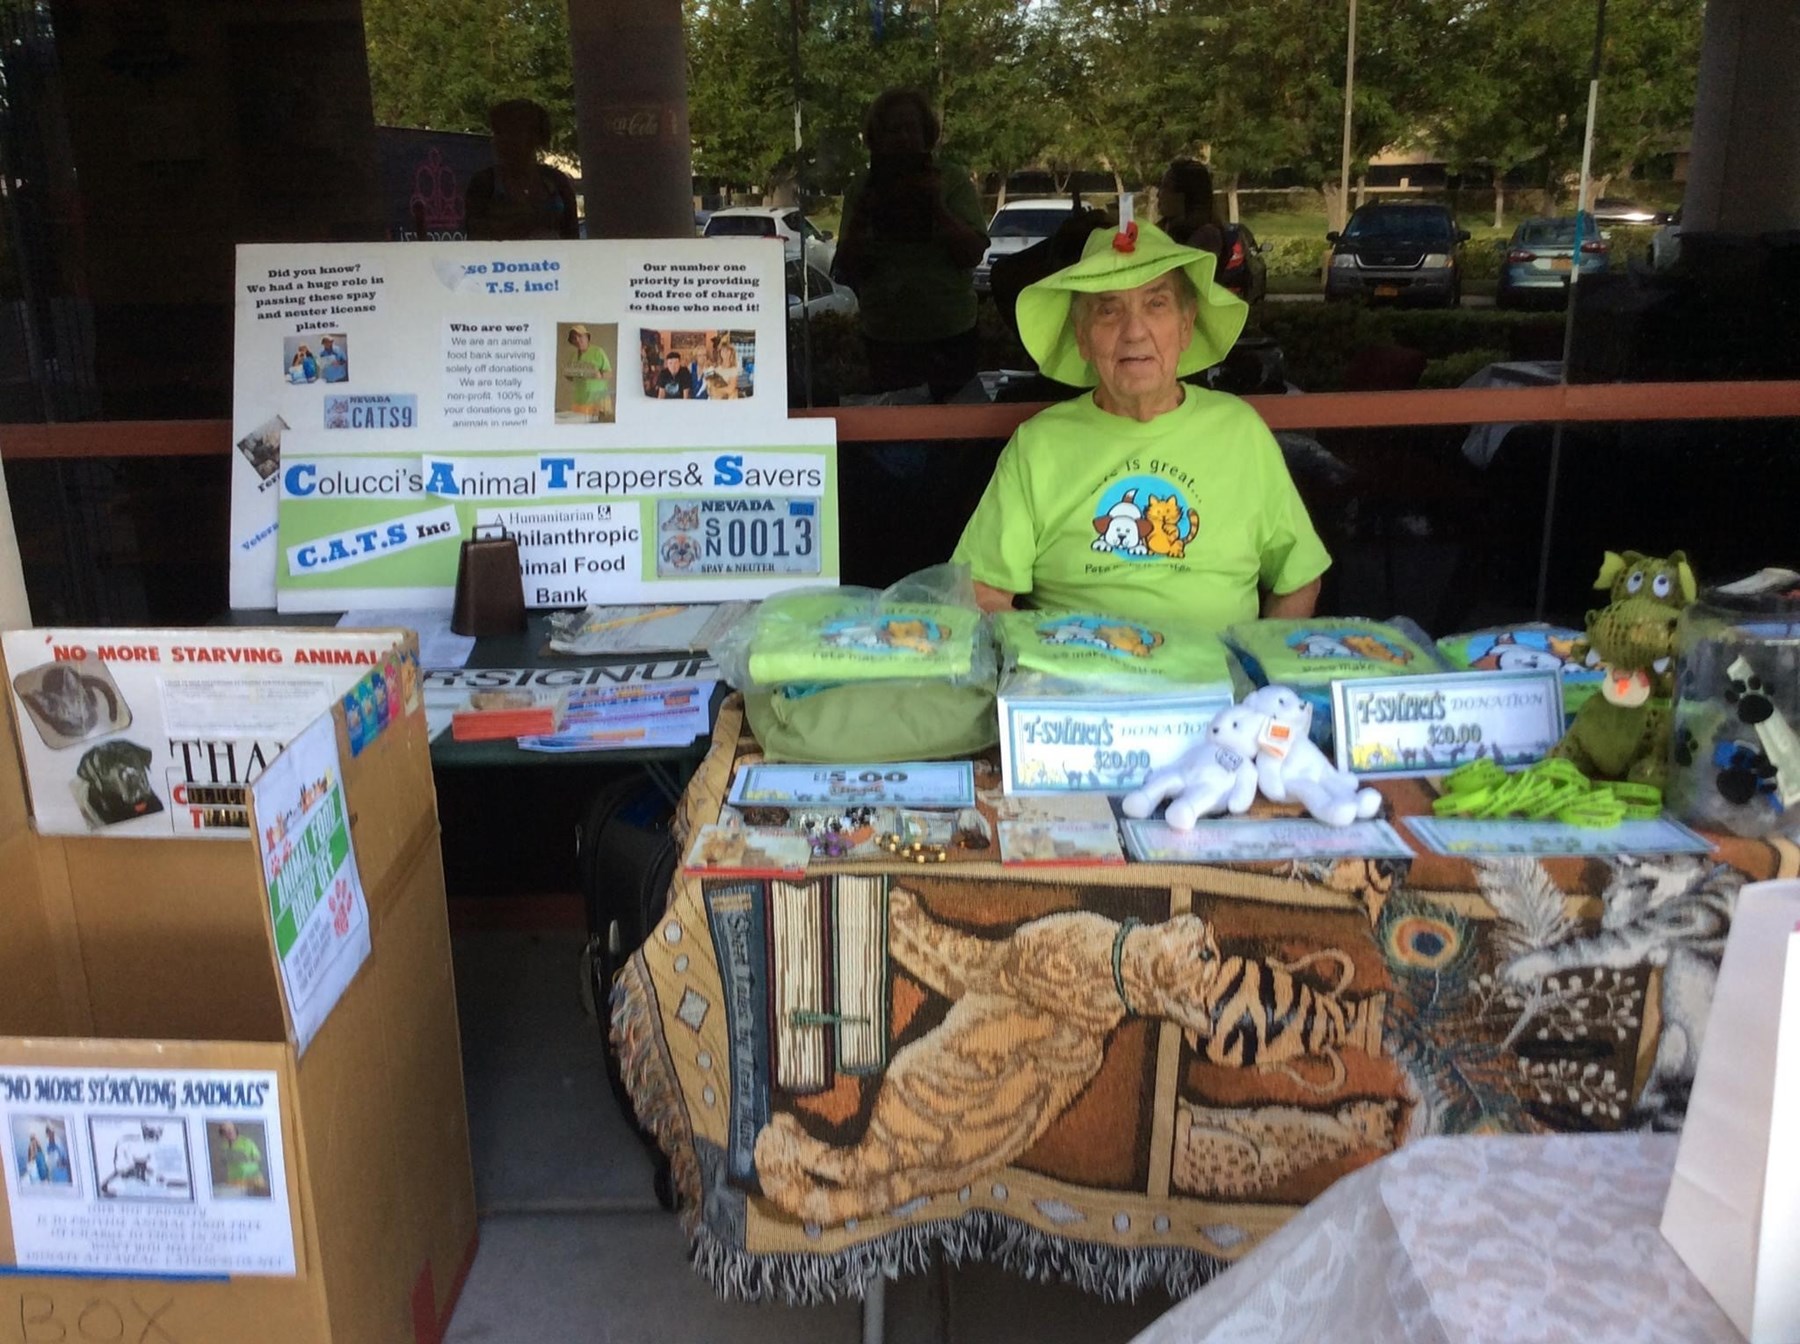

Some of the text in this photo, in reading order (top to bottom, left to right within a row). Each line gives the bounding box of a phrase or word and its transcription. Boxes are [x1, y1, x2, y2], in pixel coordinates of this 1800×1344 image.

[267, 264, 361, 279] Did you know?
[492, 260, 560, 274] Donate
[643, 263, 746, 272] Our number one
[247, 284, 266, 293] We
[269, 281, 293, 291] had
[307, 279, 338, 291] huge
[341, 277, 367, 287] role
[370, 275, 384, 285] in
[486, 280, 559, 293] T.S. inc!
[630, 276, 760, 287] priority is providing
[255, 291, 376, 308] passing these spay
[634, 290, 755, 301] food free of charge
[257, 303, 376, 320] and neuter license
[629, 303, 760, 312] to those who need it!
[296, 320, 339, 332] plates.
[449, 323, 530, 332] Who are we?
[451, 337, 532, 346] We are an animal
[447, 350, 536, 361] food bank surviving
[445, 364, 472, 374] solely
[474, 364, 486, 373] off
[459, 377, 522, 388] We are totally
[497, 391, 523, 400] 100%
[525, 391, 535, 400] of
[352, 407, 412, 429] CATS9
[444, 405, 538, 416] your donations go to
[1125, 458, 1141, 471] is
[284, 464, 423, 497] Colucci's
[425, 461, 537, 496] Animal
[713, 455, 822, 489] Savers
[701, 500, 776, 512] NEVADA
[495, 513, 504, 526] A
[509, 510, 594, 525] Humanitarian
[242, 522, 279, 550] Vetera
[297, 520, 452, 567] C.A.T.S Inc
[728, 517, 812, 557] 0013
[520, 555, 625, 577] imal Food
[701, 563, 775, 574] SPAY & NEUTER
[536, 586, 588, 604] Bank
[98, 645, 160, 662] MORE
[172, 647, 283, 664] STARVING
[294, 649, 380, 665] ANIMAL
[1452, 693, 1543, 711] DONATION
[1121, 720, 1210, 738] DONATIO
[1427, 724, 1482, 746] $20.00
[169, 738, 285, 785] THA
[1094, 747, 1150, 769] $20.00
[34, 1076, 84, 1102] MORE
[88, 1074, 177, 1111] STARVING
[19, 1292, 176, 1344] BOX
